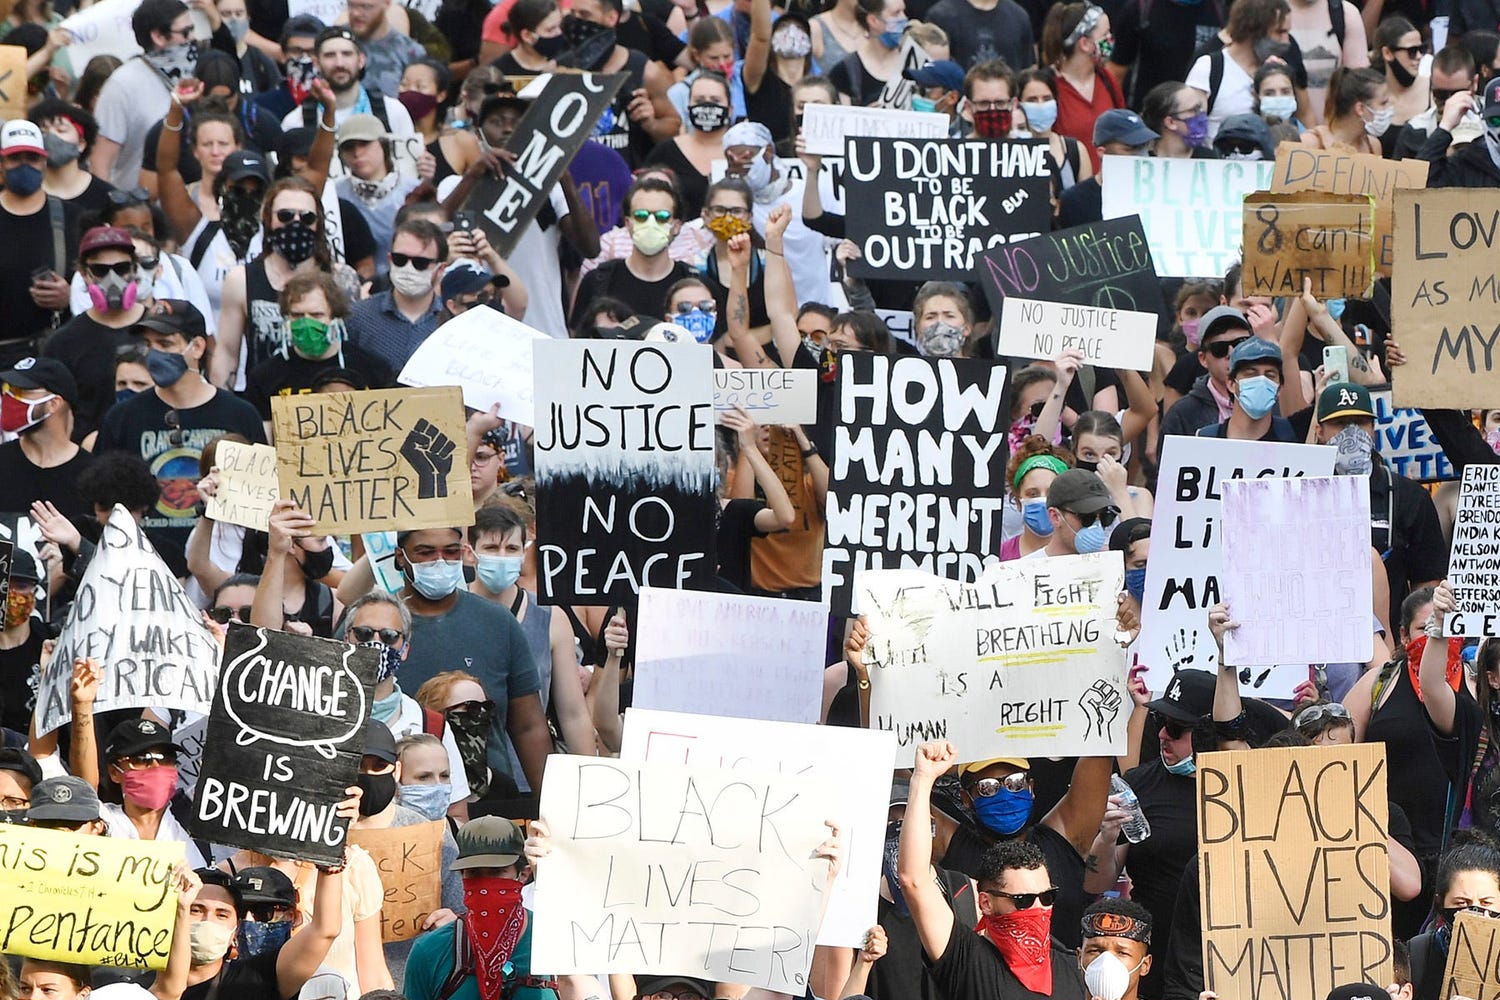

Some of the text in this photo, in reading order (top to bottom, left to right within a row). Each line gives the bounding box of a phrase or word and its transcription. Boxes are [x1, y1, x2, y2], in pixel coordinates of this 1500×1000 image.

[849, 140, 1051, 182] U DONT HAVE
[1285, 147, 1411, 199] DEFUND
[884, 191, 992, 227] BLACK
[912, 177, 974, 195] TO BE
[1002, 189, 1029, 214] BLM
[915, 224, 965, 239] TO BE
[1257, 204, 1283, 255] 8
[985, 248, 1040, 296] NO
[1412, 279, 1449, 307] AS
[1021, 302, 1118, 331] NO JUSTICE
[1033, 332, 1102, 359] NO PEACE
[582, 347, 672, 394] NO
[840, 354, 1007, 430] HOW
[296, 399, 403, 440] BLACK
[536, 402, 714, 451] JUSTICE
[299, 437, 398, 478] LIVES
[833, 427, 1003, 487] MANY
[1465, 467, 1498, 481] ERIC
[290, 476, 415, 523] MATTER
[582, 495, 675, 542] NO
[1461, 495, 1500, 508] TYREE
[826, 492, 1002, 556] WEREN'T
[1456, 527, 1488, 540] INDIA
[539, 544, 705, 598] PEACE
[1451, 559, 1500, 570] ANTWON
[976, 619, 1100, 656] BREATHING
[238, 654, 349, 717] CHANGE
[989, 670, 1003, 690] A
[878, 699, 1069, 747] HUMAN RIGHT
[263, 753, 294, 782] IS
[199, 777, 347, 847] BREWING
[572, 763, 806, 871] BLACK
[1199, 759, 1389, 844] BLACK
[67, 844, 173, 912] is my
[602, 855, 762, 917] LIVES
[1203, 842, 1390, 932] LIVES
[100, 953, 149, 968] #BLM
[570, 913, 814, 986] MATTER!
